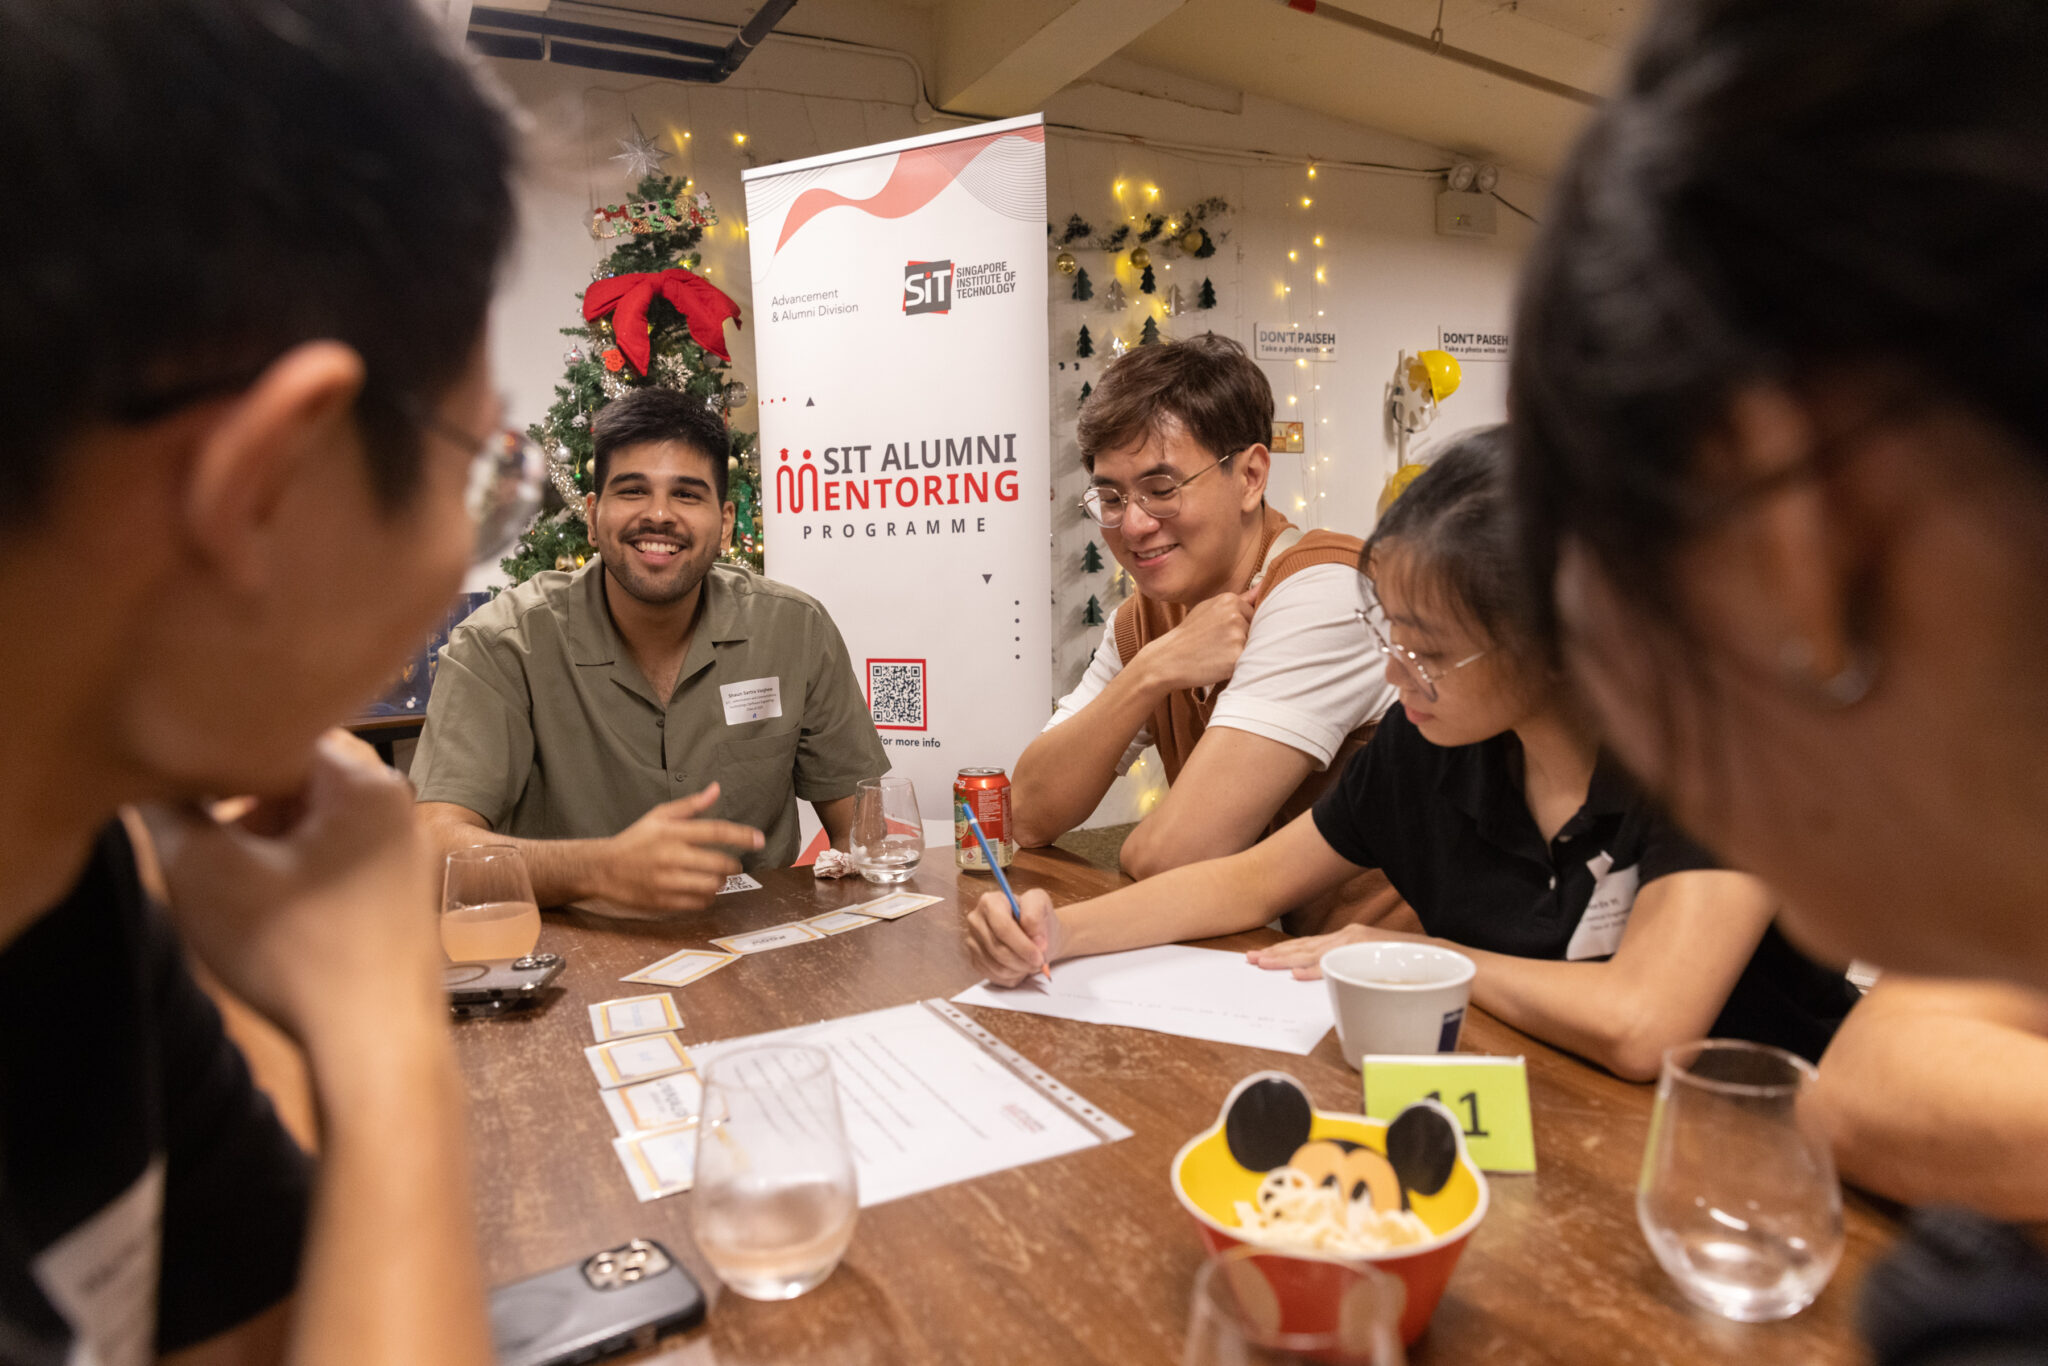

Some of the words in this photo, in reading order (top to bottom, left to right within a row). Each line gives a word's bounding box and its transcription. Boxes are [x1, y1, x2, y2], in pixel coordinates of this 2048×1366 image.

[956, 261, 1007, 278] SINGAPORE
[956, 273, 1002, 289] INSTITUTE
[1004, 271, 1016, 282] OF
[771, 289, 839, 307] Advancement
[956, 282, 1016, 299] TECHNOLOGY
[772, 311, 779, 322] &
[782, 308, 816, 321] Alumni
[818, 304, 859, 316] Division
[1260, 331, 1296, 343] DON'T
[1298, 332, 1336, 345] PAISEH
[1443, 333, 1474, 344] DON'T
[1476, 334, 1509, 346] PAISEH
[1285, 345, 1304, 354] photo
[824, 445, 871, 475] SIT
[881, 433, 1017, 472] ALUMNI
[803, 517, 986, 540] PROGRAMME
[896, 738, 920, 747] more
[922, 737, 941, 748] info
